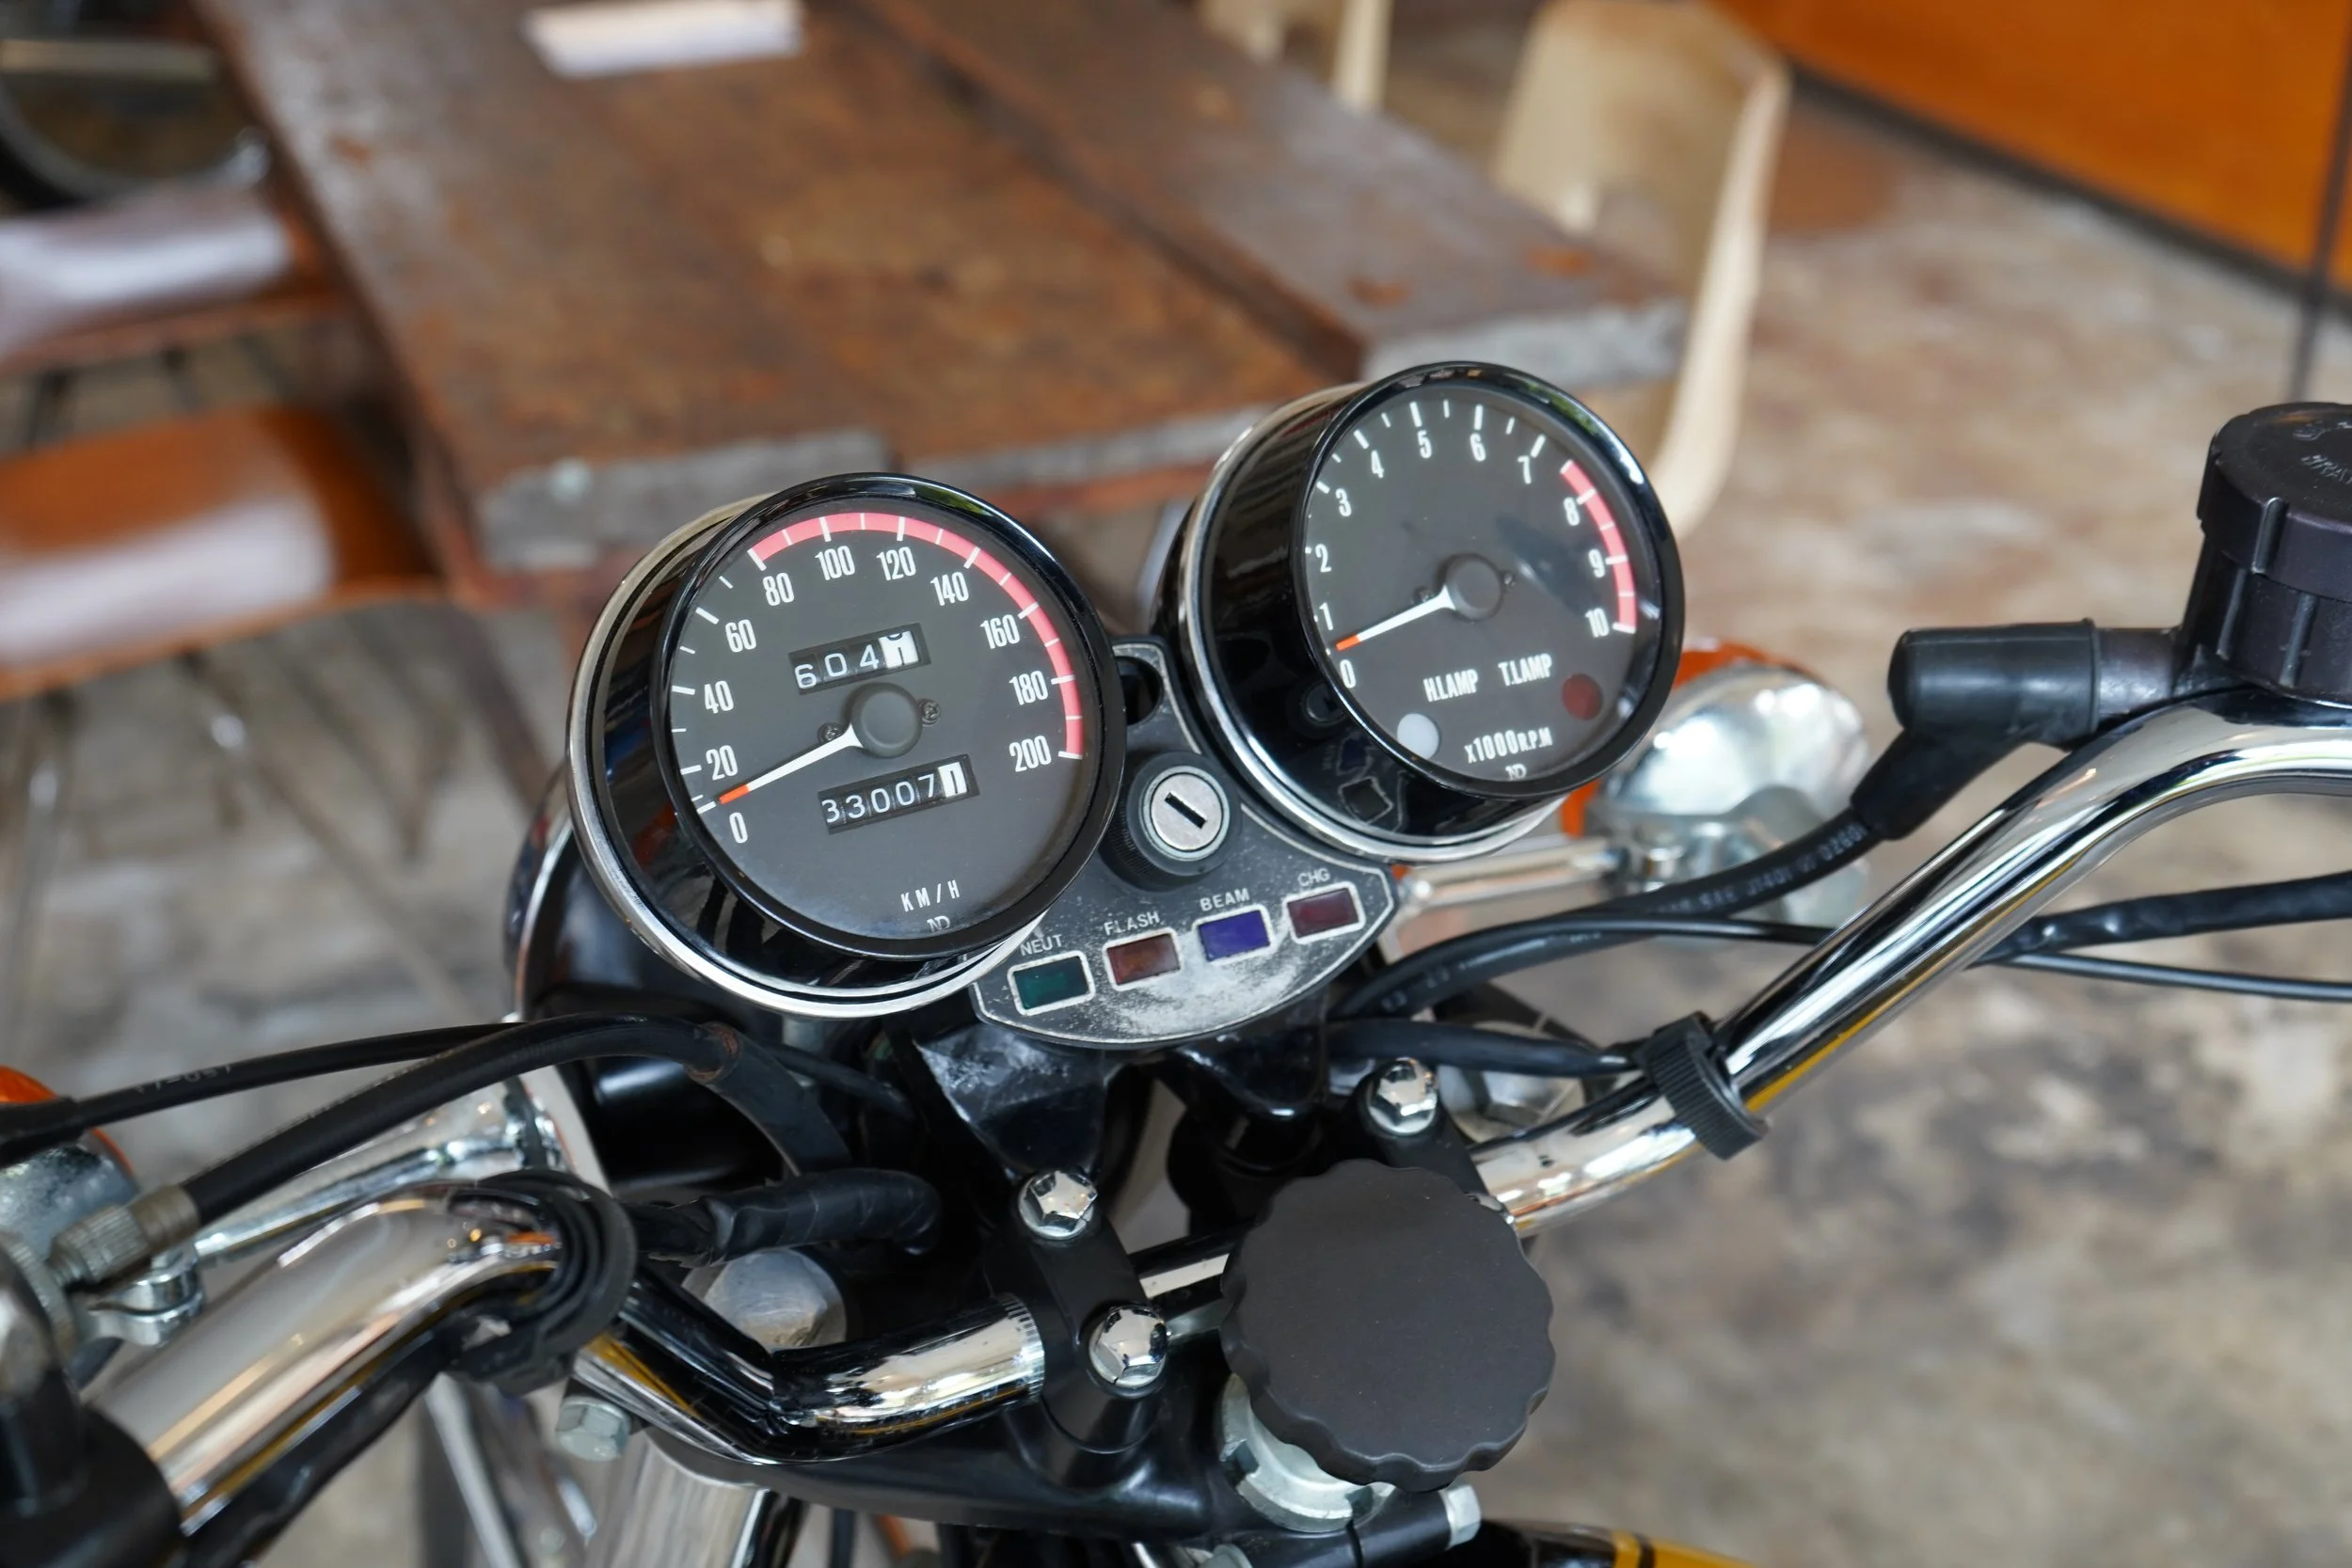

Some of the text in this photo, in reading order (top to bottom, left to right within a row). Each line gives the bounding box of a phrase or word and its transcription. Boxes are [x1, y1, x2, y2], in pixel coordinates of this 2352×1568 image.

[1417, 430, 1433, 459] 5
[1470, 432, 1486, 462] 6
[1371, 450, 1385, 479] 4
[1517, 455, 1532, 484] 7
[1335, 487, 1352, 517] 3
[1564, 497, 1581, 527] 8
[814, 545, 856, 581] 100
[876, 546, 917, 581] 120
[1314, 543, 1332, 573] 2
[1587, 548, 1605, 578] 9
[762, 572, 795, 607] 80
[930, 571, 970, 607] 140
[979, 613, 1021, 650] 160
[1319, 602, 1334, 631] 1
[1584, 607, 1611, 639] 10
[724, 619, 757, 653] 60
[1009, 670, 1049, 705] 180
[1339, 658, 1357, 689] 0
[704, 680, 735, 715] 40
[705, 744, 739, 781] 20
[1009, 735, 1053, 773] 200
[821, 769, 960, 824] 330071
[728, 812, 749, 844] 0
[1296, 867, 1331, 888] CHG
[1199, 887, 1251, 912] BEAM
[1103, 911, 1161, 937] FLASH
[1019, 934, 1063, 958] NEUT
